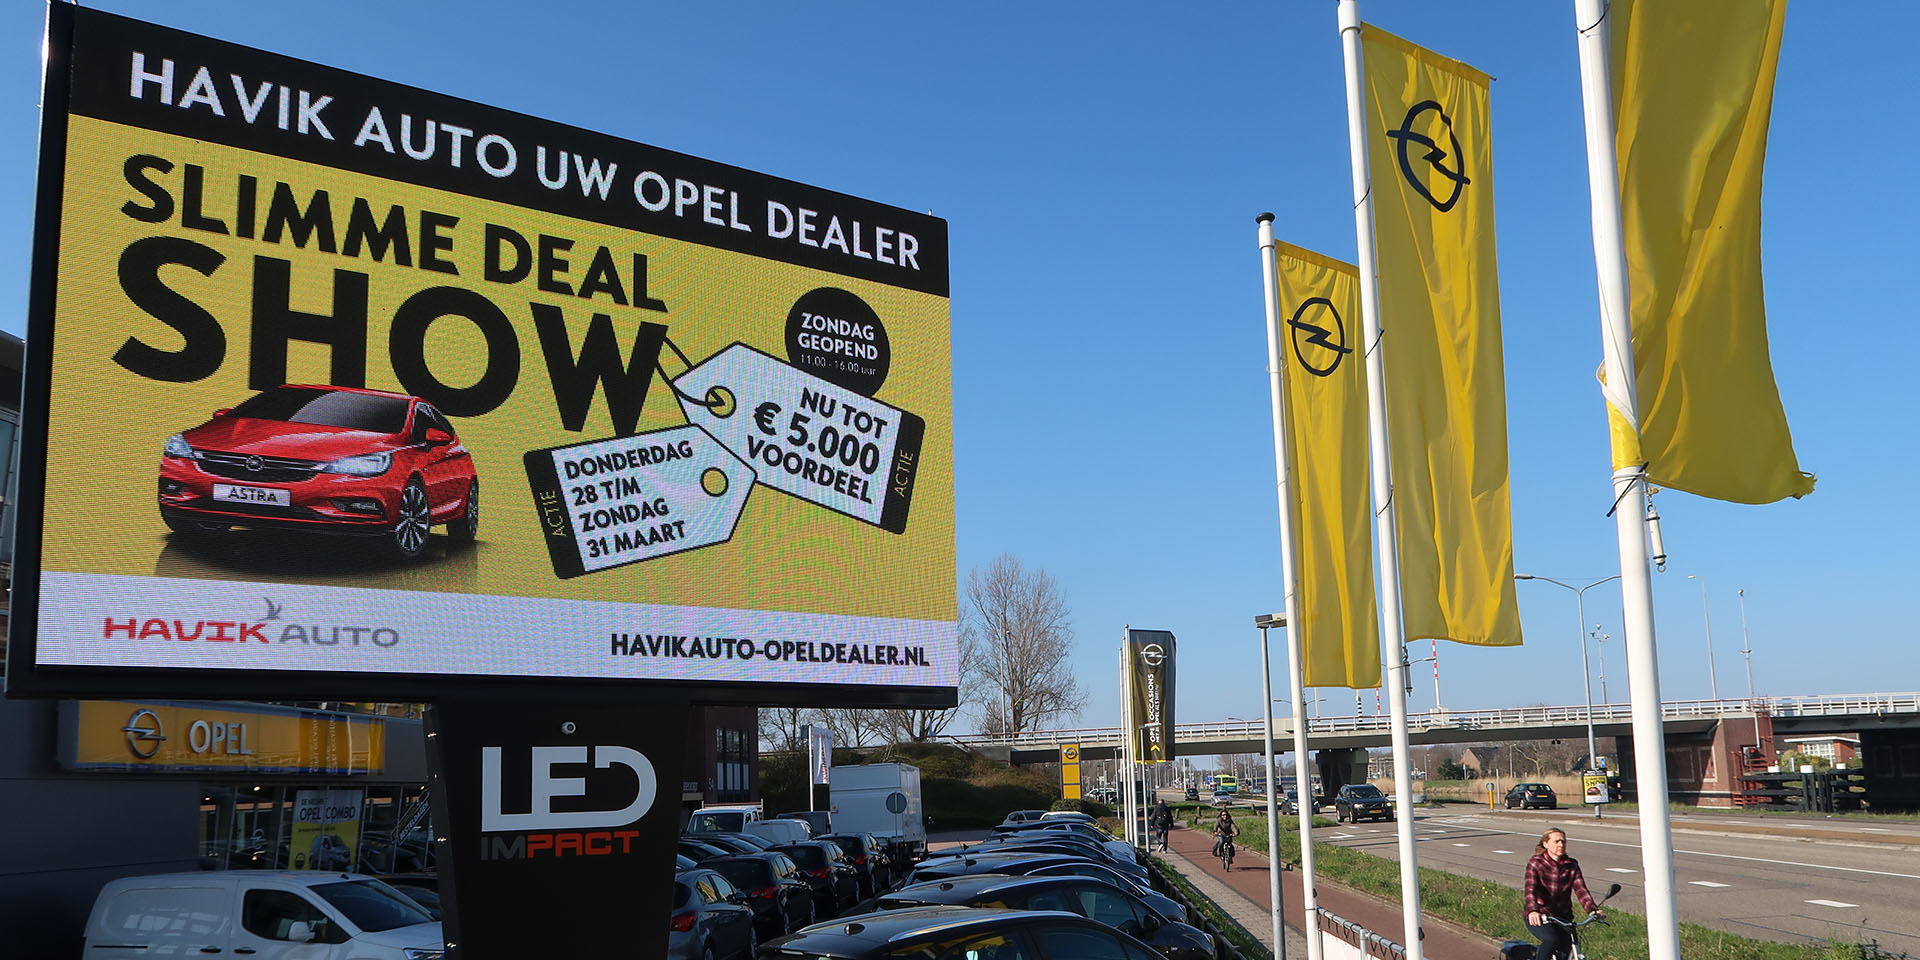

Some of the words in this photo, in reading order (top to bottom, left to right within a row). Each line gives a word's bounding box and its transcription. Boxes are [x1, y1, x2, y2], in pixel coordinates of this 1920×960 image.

[130, 51, 334, 141] HAVIK
[354, 105, 517, 179] AUTO
[536, 145, 617, 202] UW
[634, 170, 752, 233] OPEL
[767, 202, 921, 271] DEALER
[121, 154, 461, 276] SLIMME
[485, 222, 668, 312] DEAL
[112, 236, 669, 436] SHOW
[801, 312, 874, 341] ZONDAG
[797, 332, 878, 360] GEOPEND
[801, 354, 827, 369] 11.00
[834, 360, 859, 374] 16.00
[861, 366, 876, 375] uur
[800, 387, 836, 418] NU
[842, 403, 887, 439] TOT
[753, 401, 782, 436] €
[787, 411, 880, 475] 5.000
[564, 440, 693, 480] DONDERDAG
[747, 435, 872, 504] VOORDEEL
[893, 449, 914, 498] ACTIE
[227, 486, 279, 503] ASTRA
[572, 485, 599, 506] 28
[600, 476, 641, 500] T/M
[540, 490, 567, 537] ACTIE
[579, 498, 669, 532] ZONDAG
[586, 536, 609, 558] 31
[614, 520, 685, 553] MAART
[103, 616, 269, 645] HAVIK
[278, 624, 400, 649] AUTO
[611, 632, 930, 668] HAVIKAUTO-OPELDEALER.NL
[1147, 673, 1155, 720] OCCASIONS
[189, 720, 253, 755] OPEL
[481, 745, 657, 833] LED
[300, 807, 321, 821] OPEL
[325, 806, 356, 820] COMBO
[481, 830, 640, 862] IMPACT
